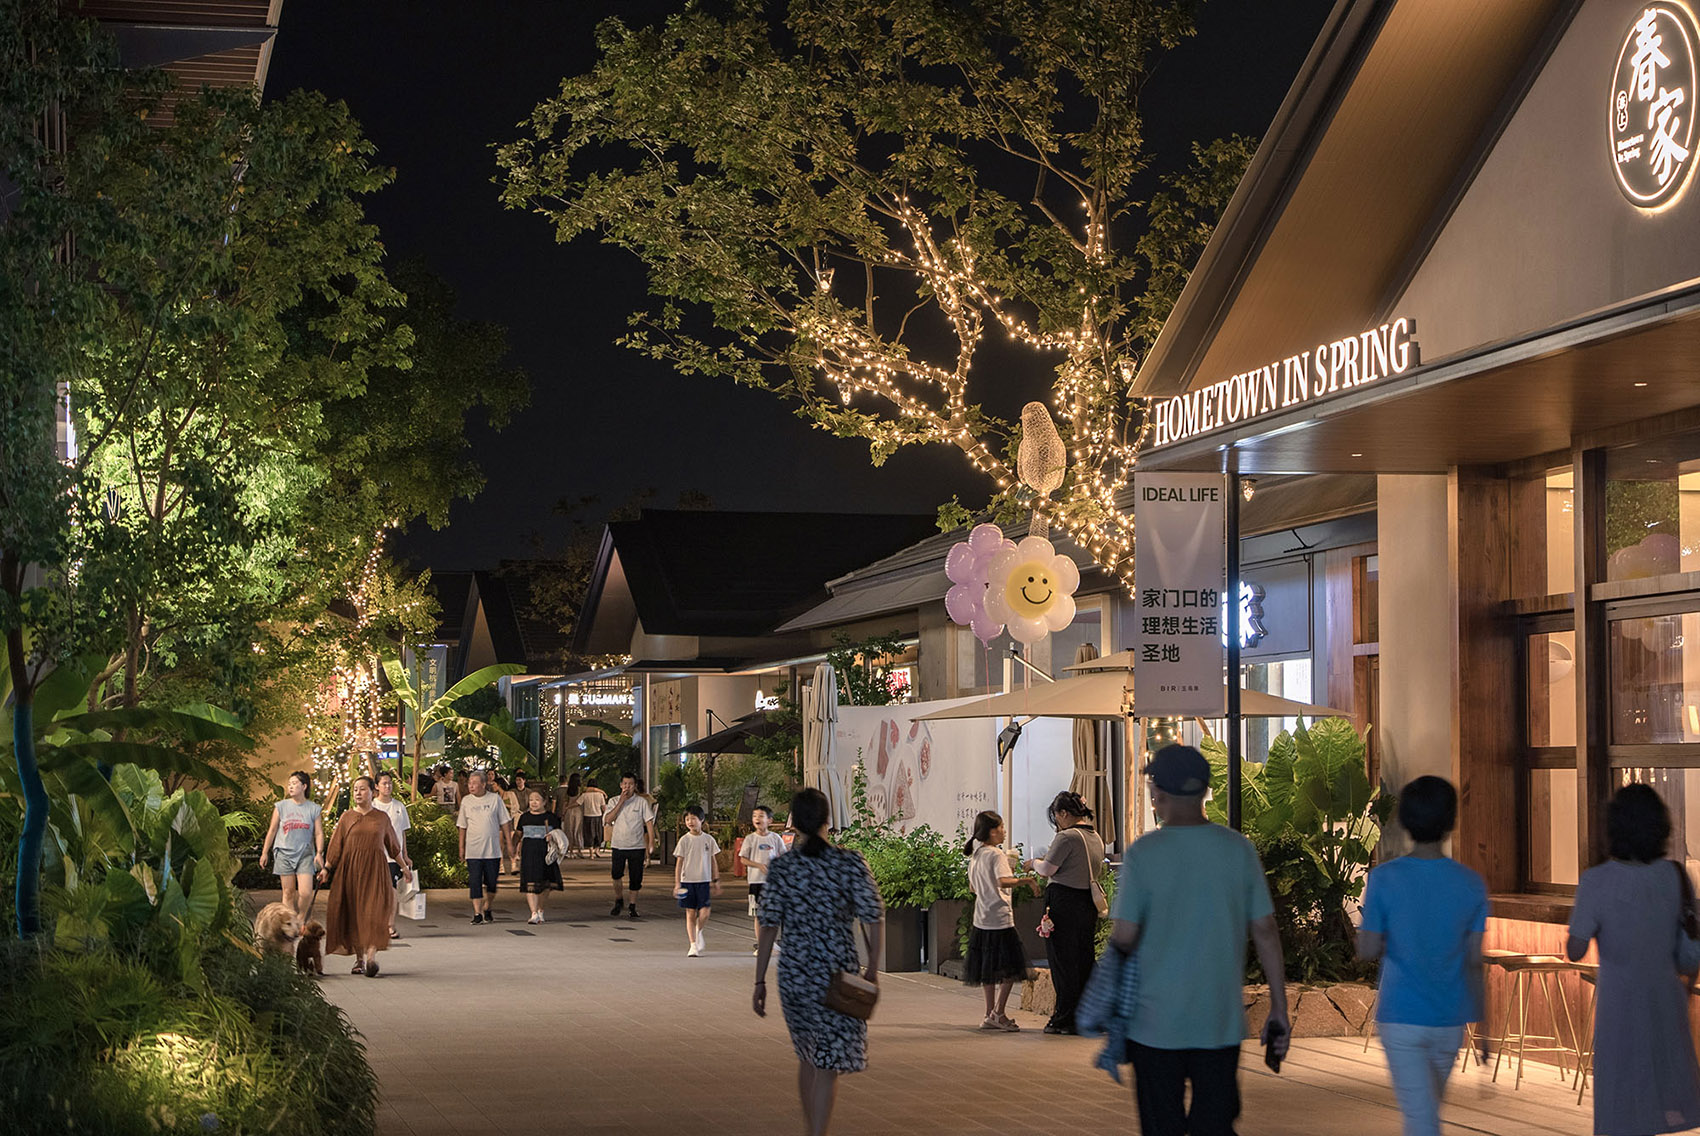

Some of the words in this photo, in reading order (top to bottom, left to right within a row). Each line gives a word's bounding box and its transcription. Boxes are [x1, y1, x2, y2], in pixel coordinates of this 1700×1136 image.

[1629, 8, 1690, 187] 春家
[1154, 361, 1280, 447] HOMETOWN
[1281, 351, 1310, 407] IN
[1313, 317, 1411, 397] SPRING
[1142, 487, 1187, 502] IDEAL
[1189, 487, 1219, 502] LIFE
[1142, 588, 1218, 608] 家门口的
[1142, 616, 1217, 635] 理想生活
[1142, 643, 1180, 663] 圣地
